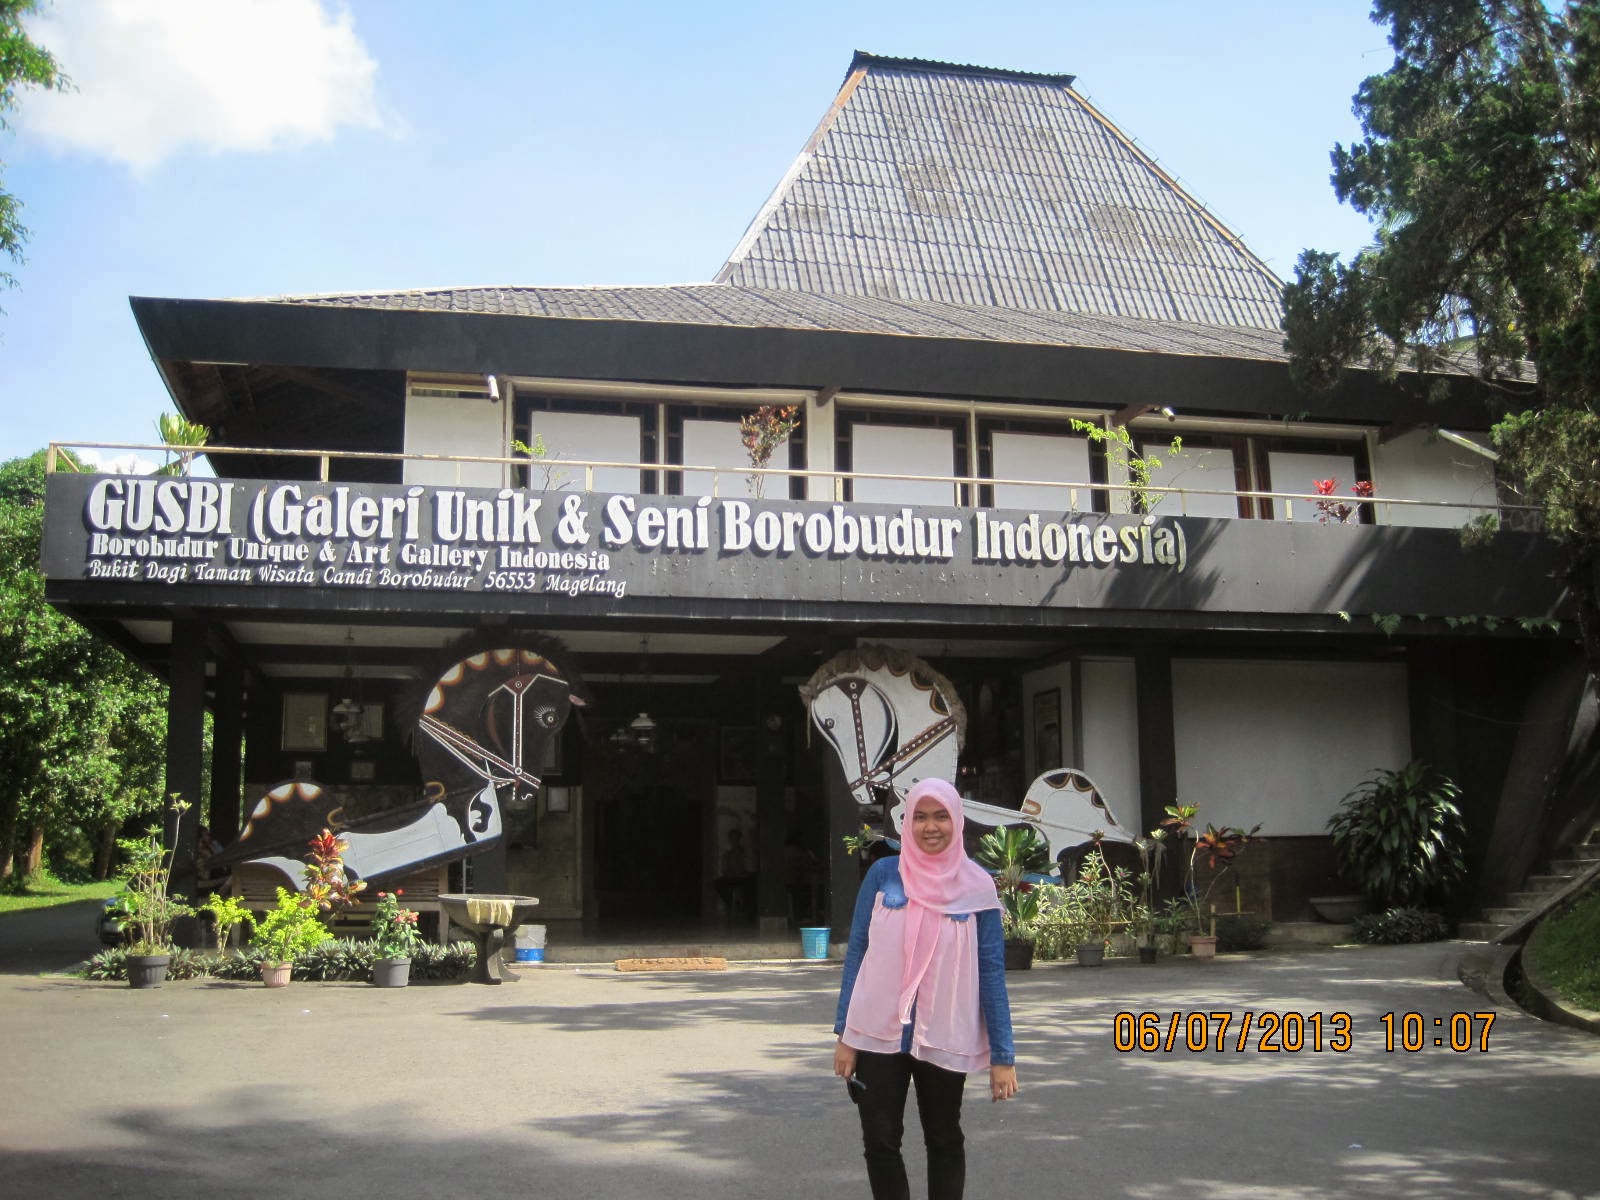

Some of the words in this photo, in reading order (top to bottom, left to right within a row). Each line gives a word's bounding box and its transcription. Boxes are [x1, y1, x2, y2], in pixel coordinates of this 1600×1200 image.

[89, 478, 234, 534] GUSBI
[253, 485, 424, 544] (Galeri
[436, 488, 542, 543] Unik
[557, 494, 590, 544] &
[604, 495, 711, 550] Seni
[721, 500, 962, 558] Borobudur
[976, 511, 1187, 573] Indonesia)
[90, 533, 218, 558] Borobudur
[231, 537, 309, 562] Unique
[319, 540, 336, 562] &
[347, 541, 391, 564] Art
[401, 543, 488, 571] Gallery
[500, 546, 610, 571] Indonesia
[90, 559, 139, 579] Bukit
[146, 561, 187, 583] Dagi
[195, 562, 251, 581] Taman
[258, 564, 314, 583] Wisata
[323, 566, 372, 586] Candi
[379, 568, 473, 589] Borobudur
[485, 571, 536, 590] 56553
[546, 574, 627, 598] Magelang
